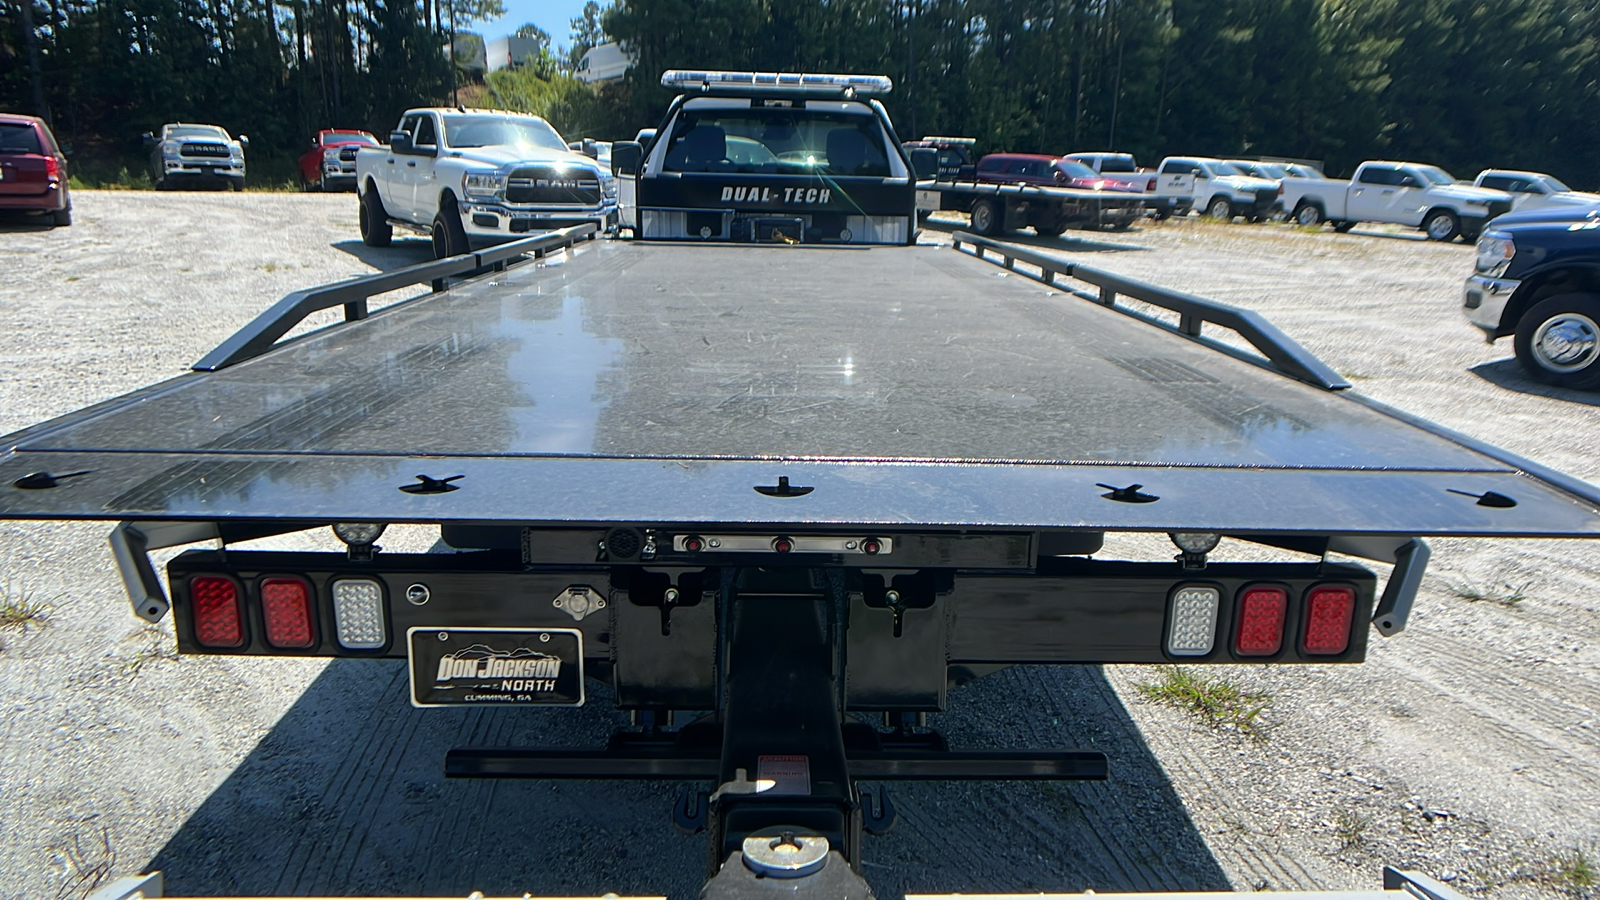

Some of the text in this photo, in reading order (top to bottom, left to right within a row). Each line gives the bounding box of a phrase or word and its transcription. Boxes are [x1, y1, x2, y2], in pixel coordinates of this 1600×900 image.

[537, 179, 576, 188] RAM
[437, 656, 561, 681] DON JACKSON
[501, 680, 555, 692] NORTH
[464, 694, 514, 702] CUMMING,
